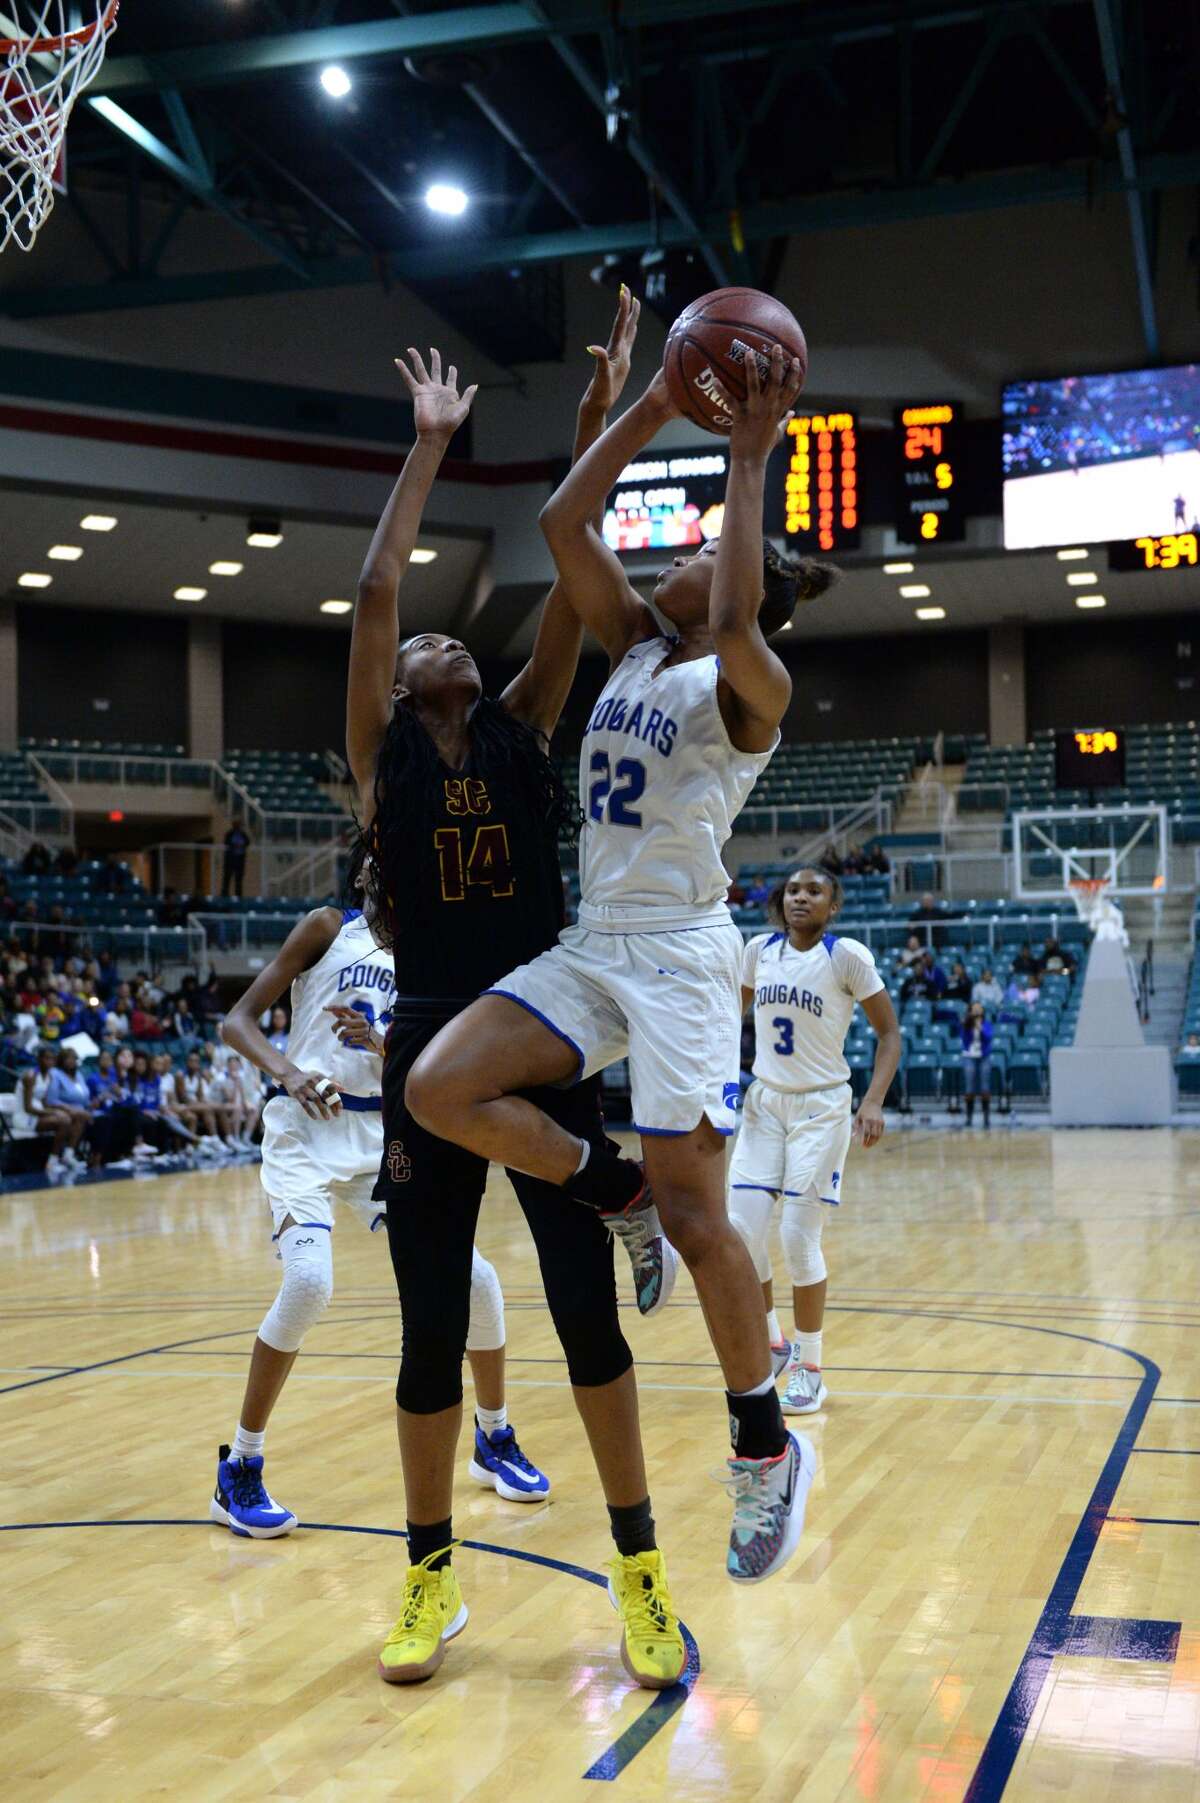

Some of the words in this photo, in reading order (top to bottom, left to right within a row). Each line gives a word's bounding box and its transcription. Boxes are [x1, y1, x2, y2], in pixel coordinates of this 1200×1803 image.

[905, 426, 942, 459] 24
[1135, 533, 1198, 568] 7:39
[589, 750, 647, 829] 22
[433, 824, 515, 901] 14
[772, 1016, 795, 1056] 3
